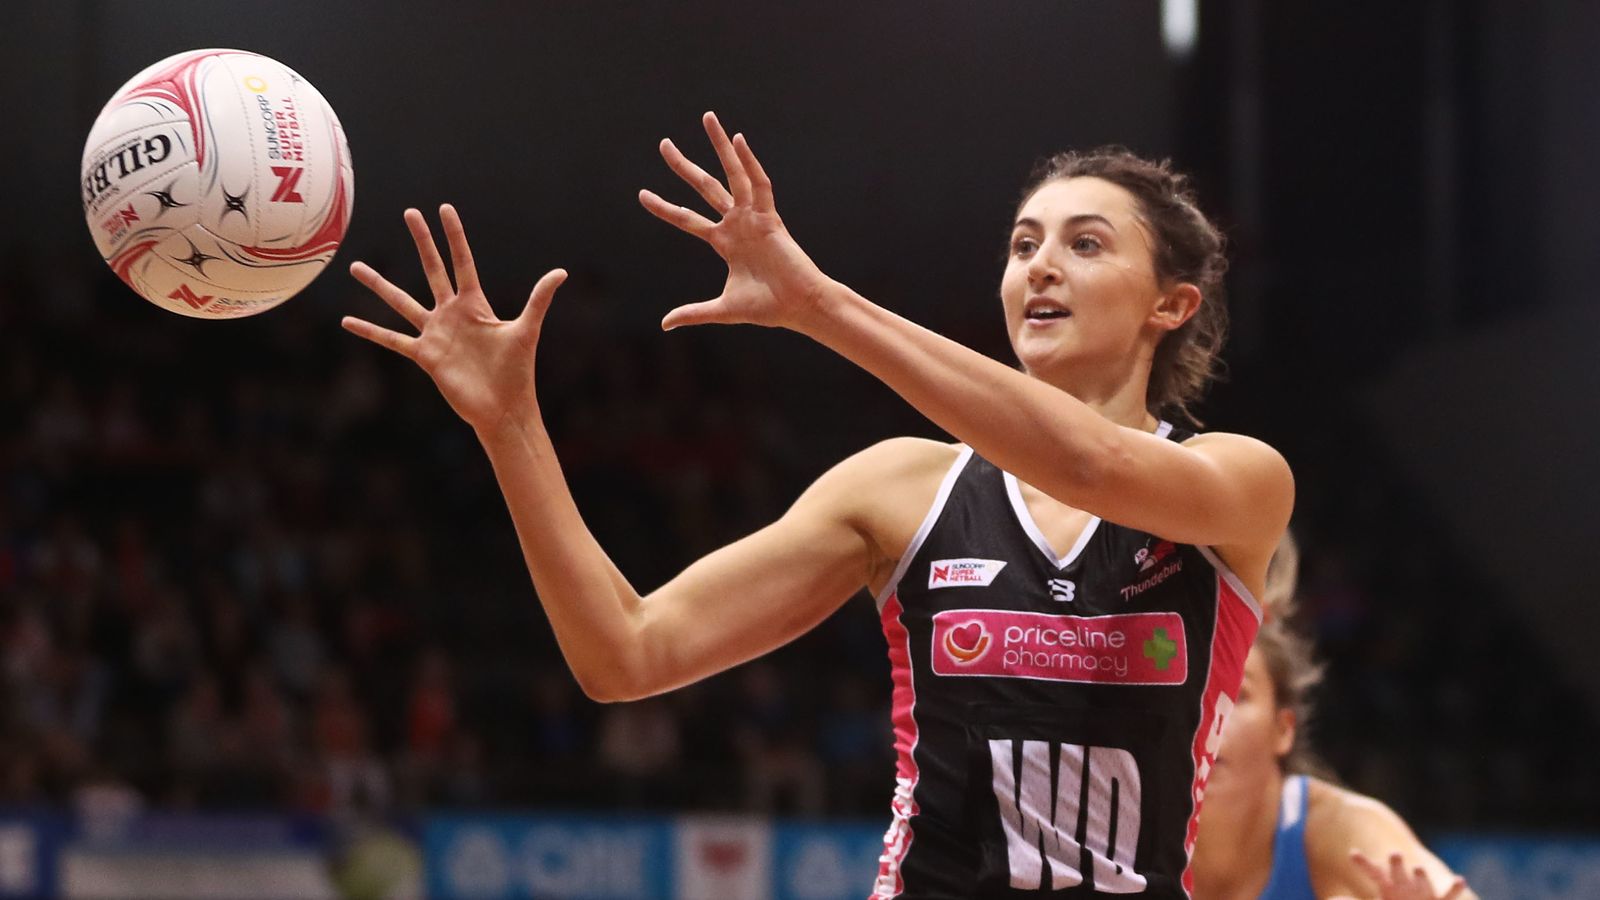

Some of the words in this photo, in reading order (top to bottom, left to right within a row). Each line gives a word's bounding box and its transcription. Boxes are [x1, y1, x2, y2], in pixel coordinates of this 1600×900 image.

[257, 94, 278, 160] SUNCORP
[275, 111, 293, 161] SUPER
[287, 97, 304, 162] NETBALL
[1003, 646, 1129, 677] pharmacy
[1004, 625, 1126, 648] priceline
[988, 738, 1148, 894] WD
